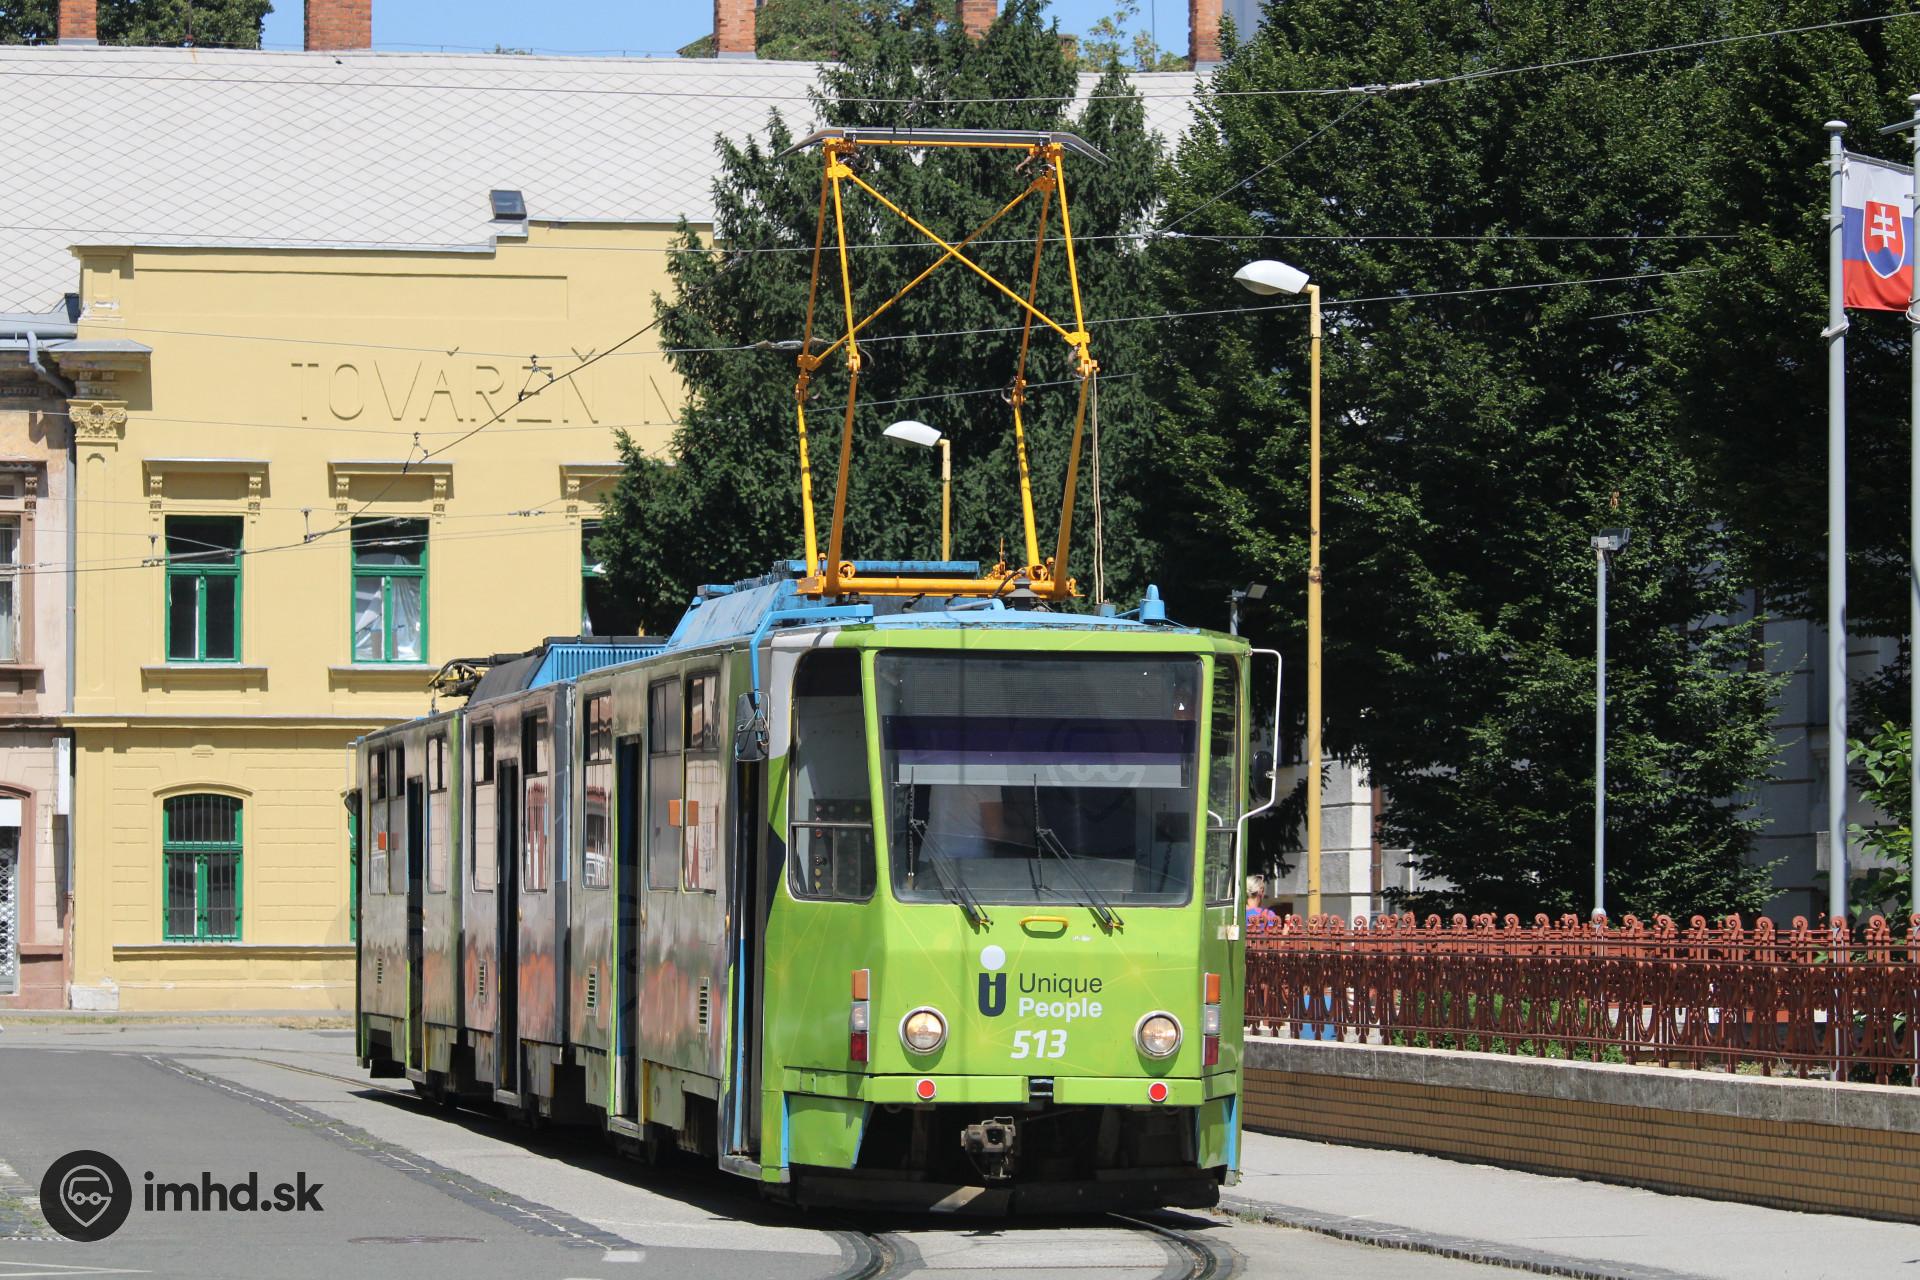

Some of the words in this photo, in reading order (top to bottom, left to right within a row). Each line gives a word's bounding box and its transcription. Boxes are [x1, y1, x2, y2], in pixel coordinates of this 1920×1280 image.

[1019, 972, 1103, 999] Unique
[1018, 997, 1103, 1023] People
[1010, 1029, 1068, 1060] 513
